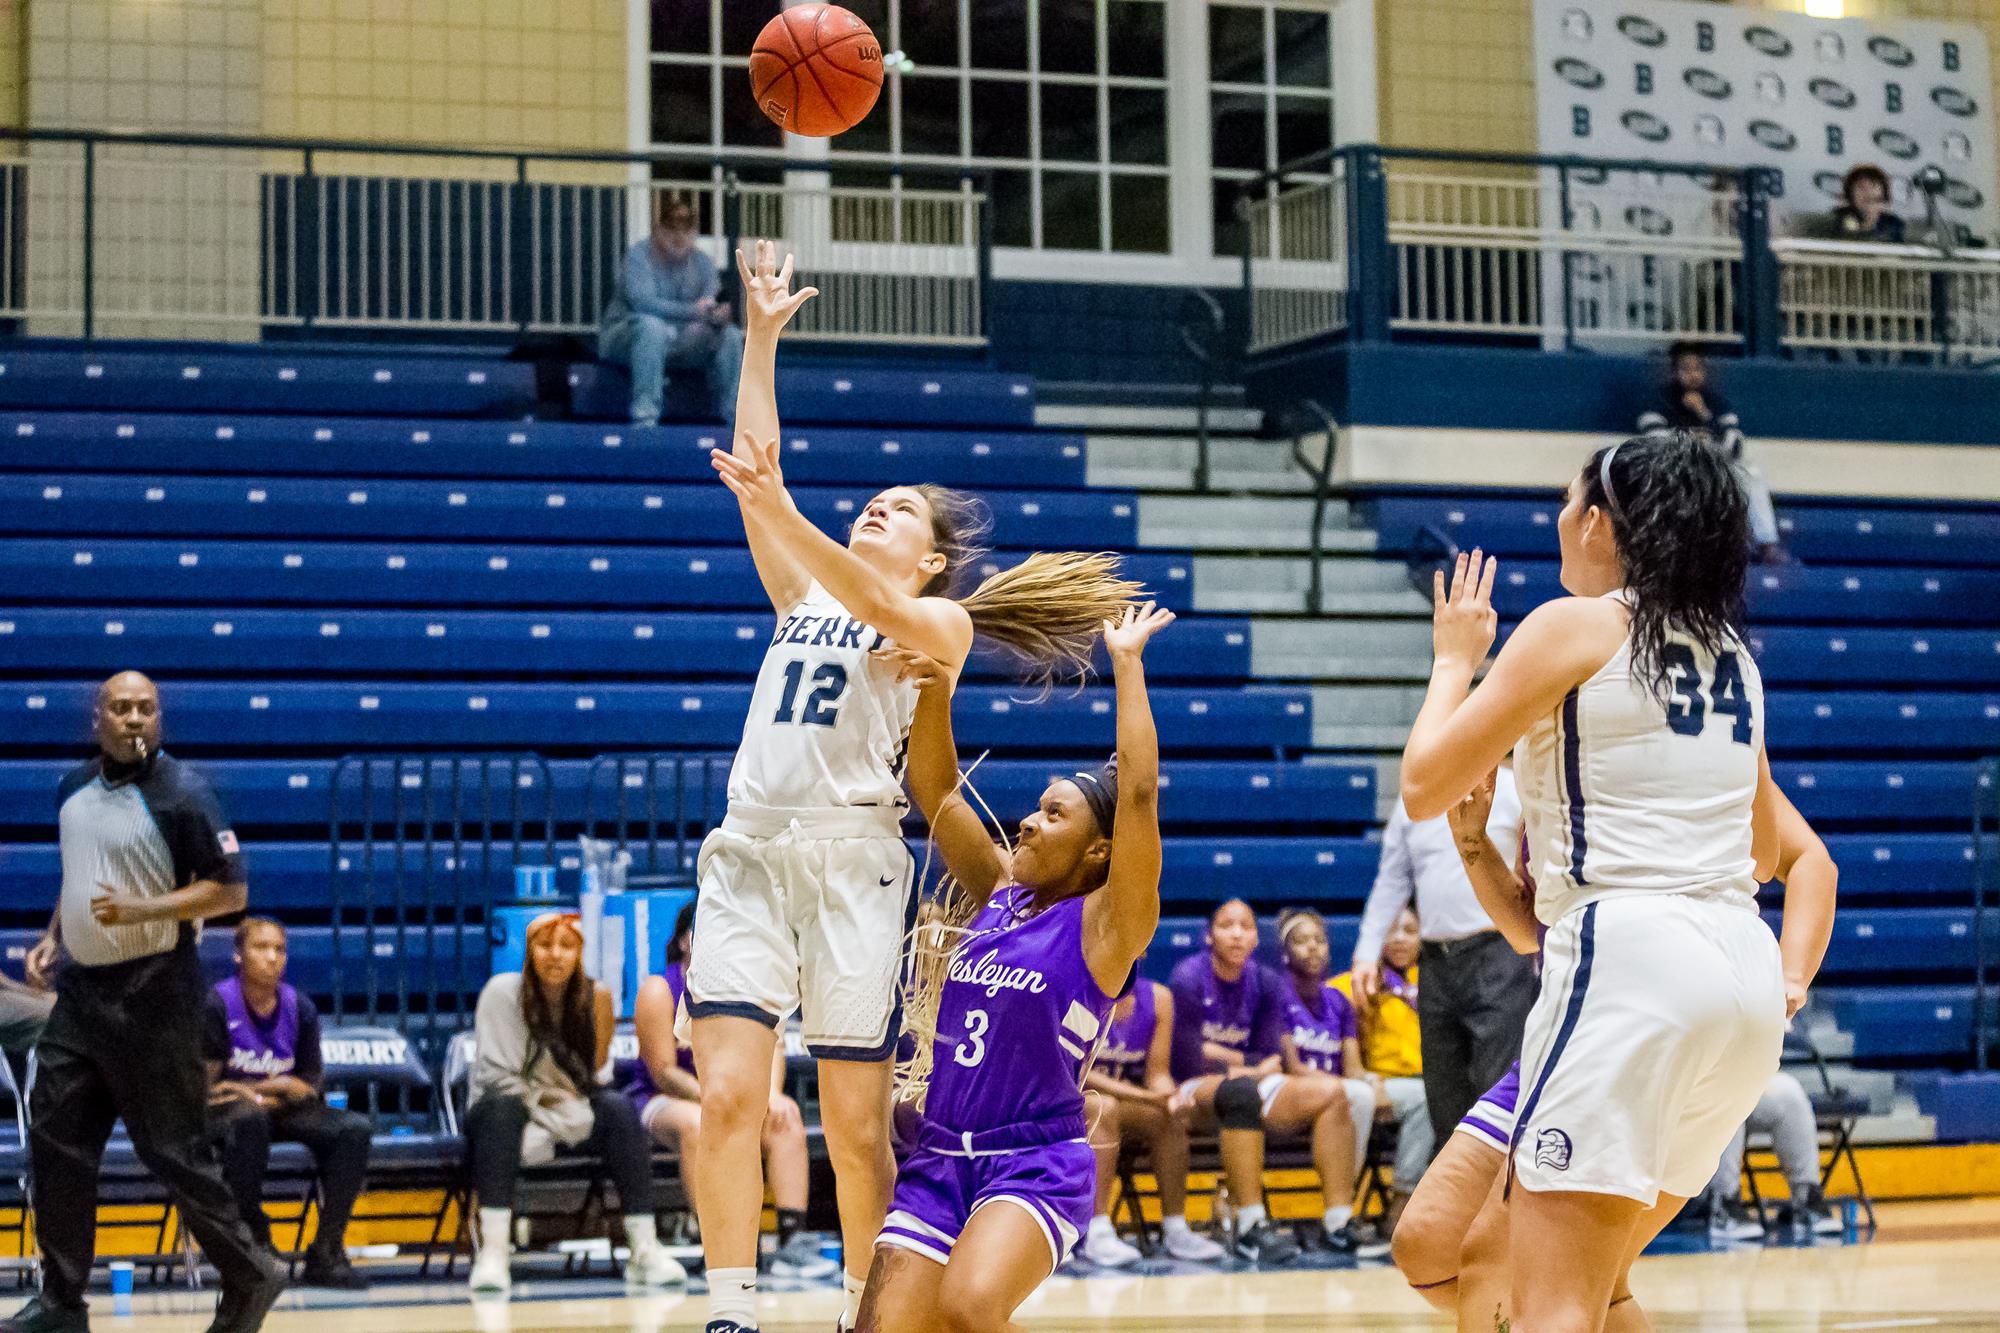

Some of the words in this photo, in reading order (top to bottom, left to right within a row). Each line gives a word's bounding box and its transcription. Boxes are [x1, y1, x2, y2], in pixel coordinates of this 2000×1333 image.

[772, 658, 848, 729] 12
[1662, 643, 1752, 745] 34
[320, 1039, 408, 1065] BERRY
[954, 1008, 989, 1067] 3
